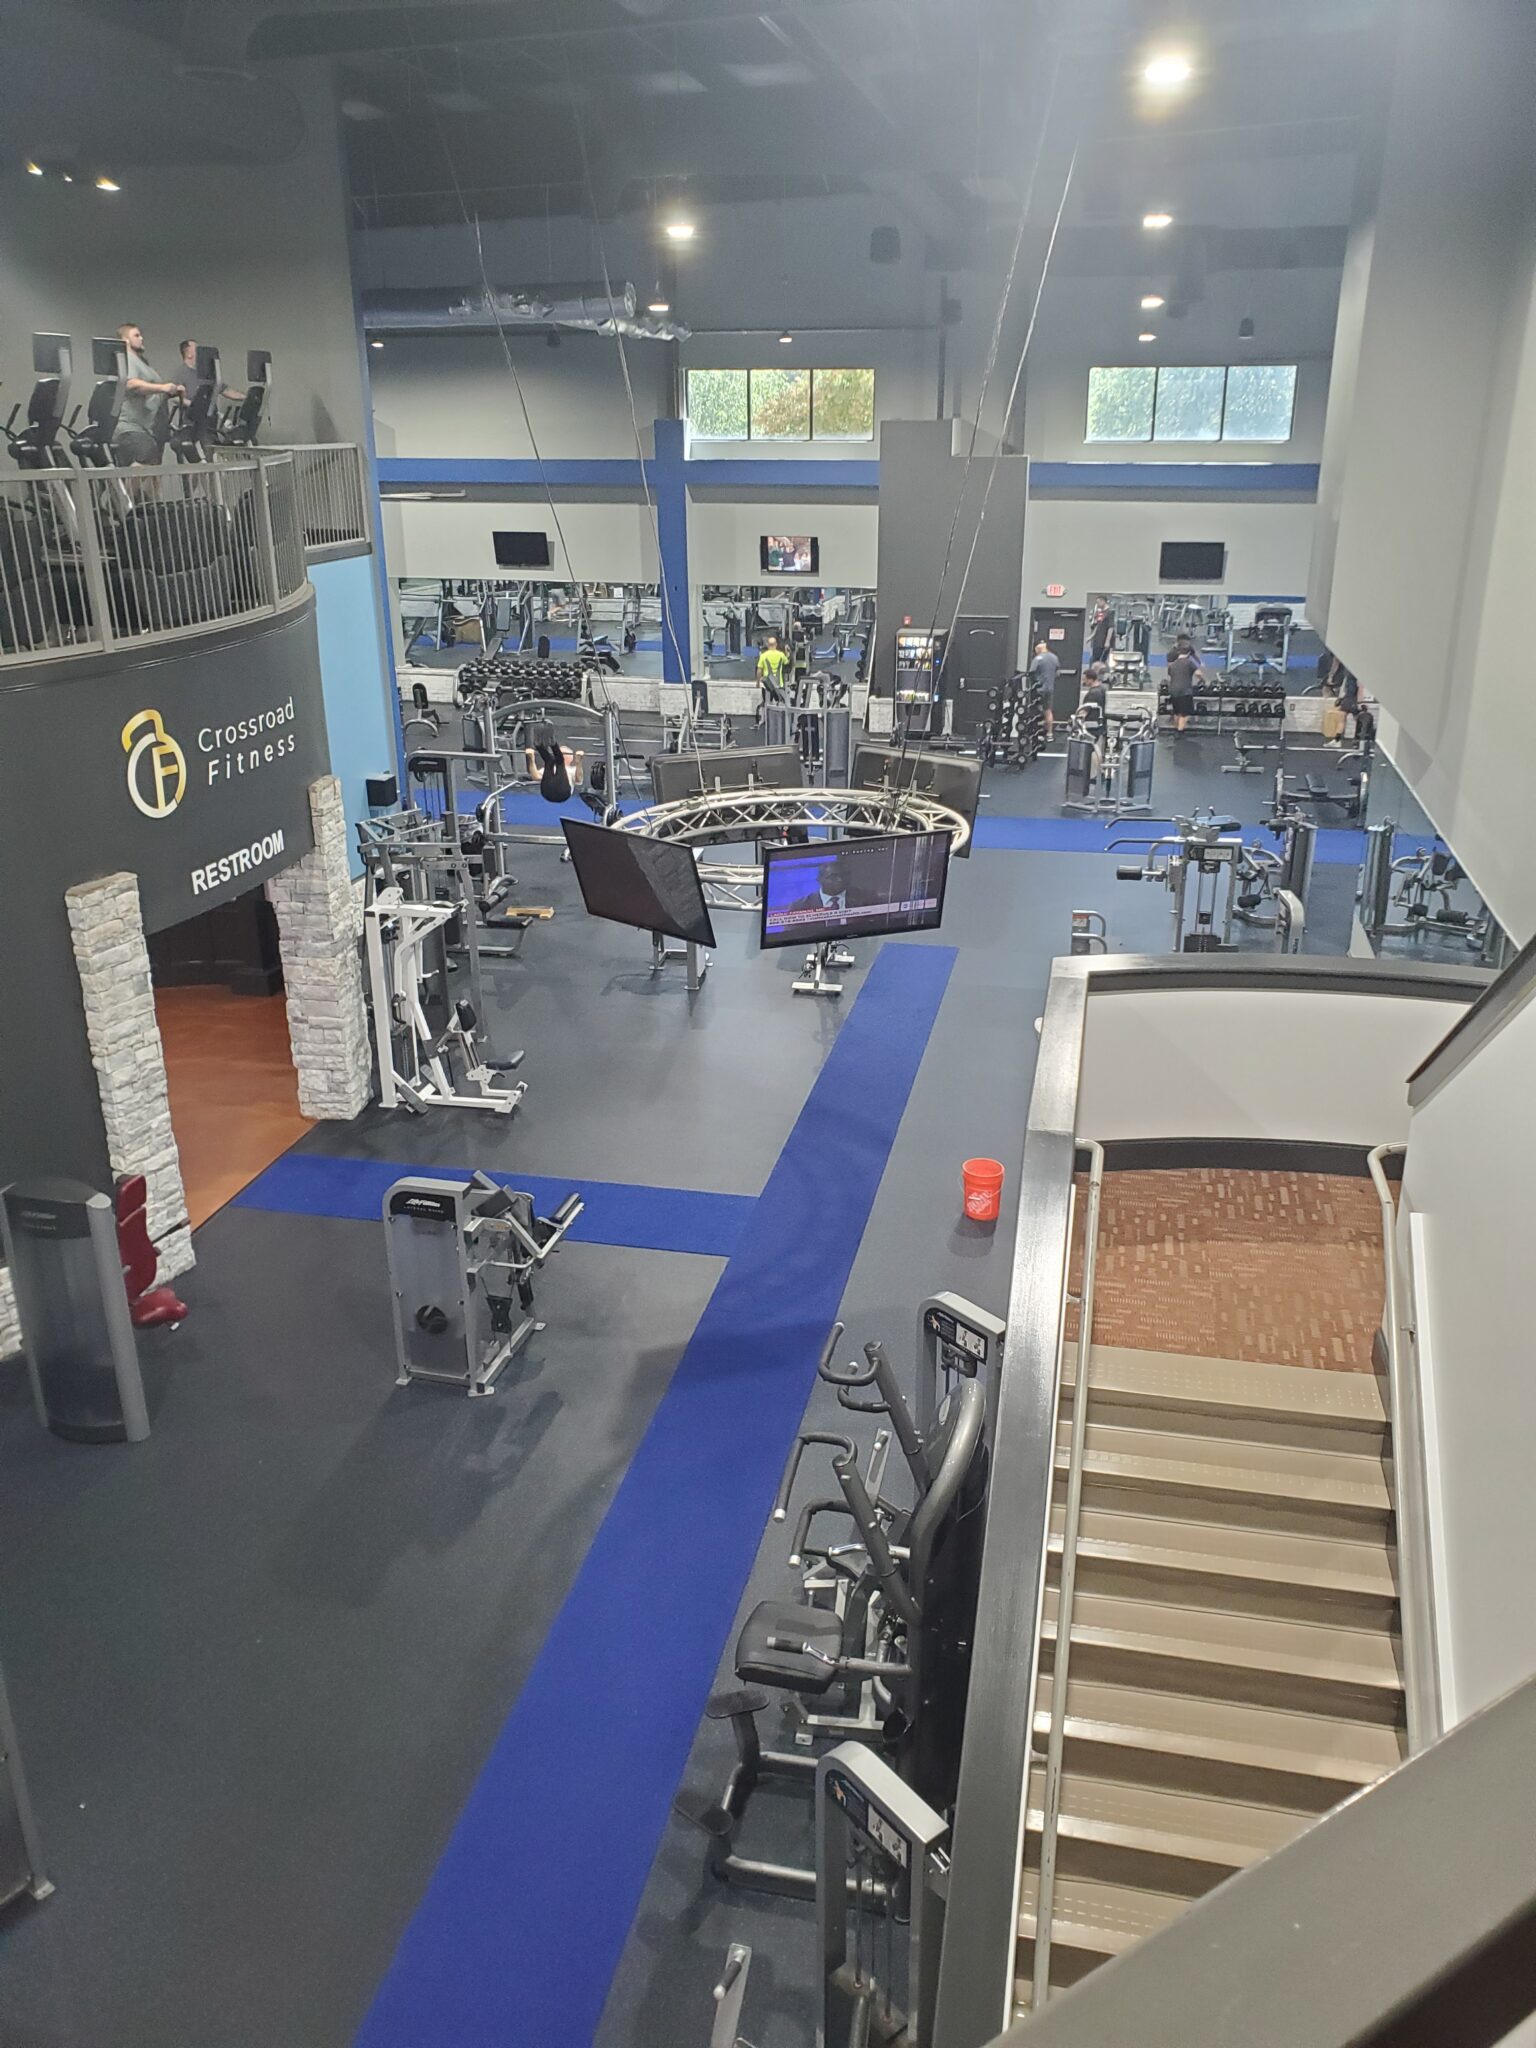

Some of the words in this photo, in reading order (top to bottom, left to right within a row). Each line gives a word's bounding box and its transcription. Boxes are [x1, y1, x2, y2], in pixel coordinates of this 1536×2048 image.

[198, 696, 295, 752] Crossroad
[208, 734, 295, 786] Fitness
[191, 829, 285, 895] RESTROOM
